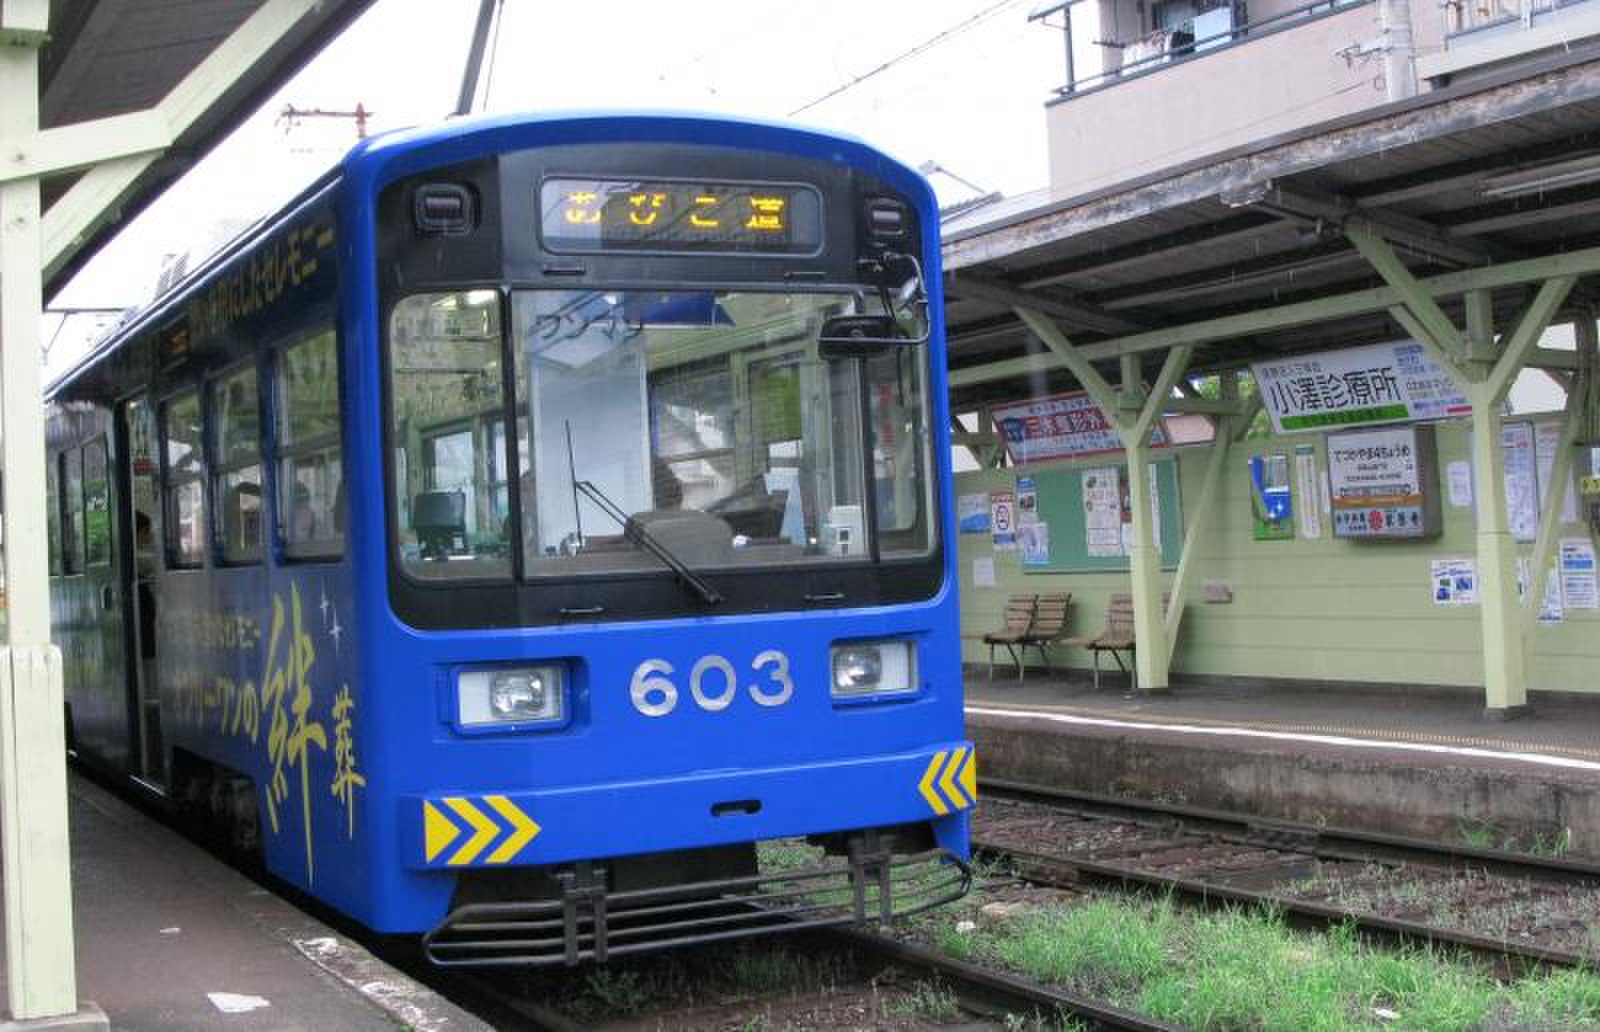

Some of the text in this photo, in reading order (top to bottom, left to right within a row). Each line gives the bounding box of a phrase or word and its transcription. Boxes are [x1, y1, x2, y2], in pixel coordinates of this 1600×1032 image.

[1270, 367, 1401, 415] 小澤診療所
[629, 649, 794, 718] 603
